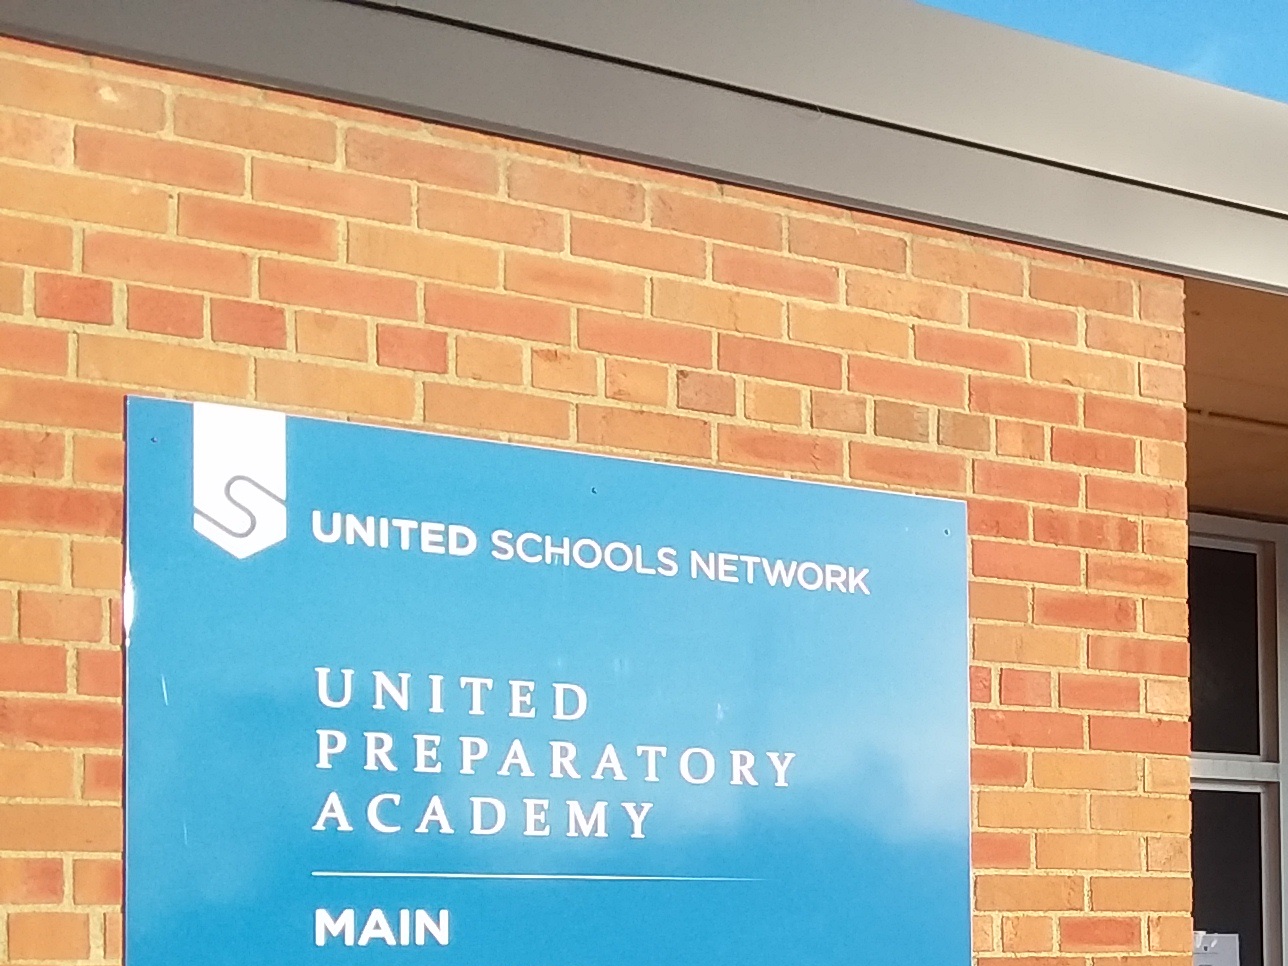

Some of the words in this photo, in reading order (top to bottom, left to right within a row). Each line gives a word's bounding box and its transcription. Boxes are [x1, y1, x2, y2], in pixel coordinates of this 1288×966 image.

[312, 509, 478, 557] UNITED
[491, 529, 679, 577] SCHOOLS
[690, 550, 872, 595] NETWORK
[314, 666, 589, 721] UNITED
[315, 729, 797, 788] PREPARATORY
[312, 791, 655, 839] ACADEMY
[314, 907, 450, 947] MAIN
